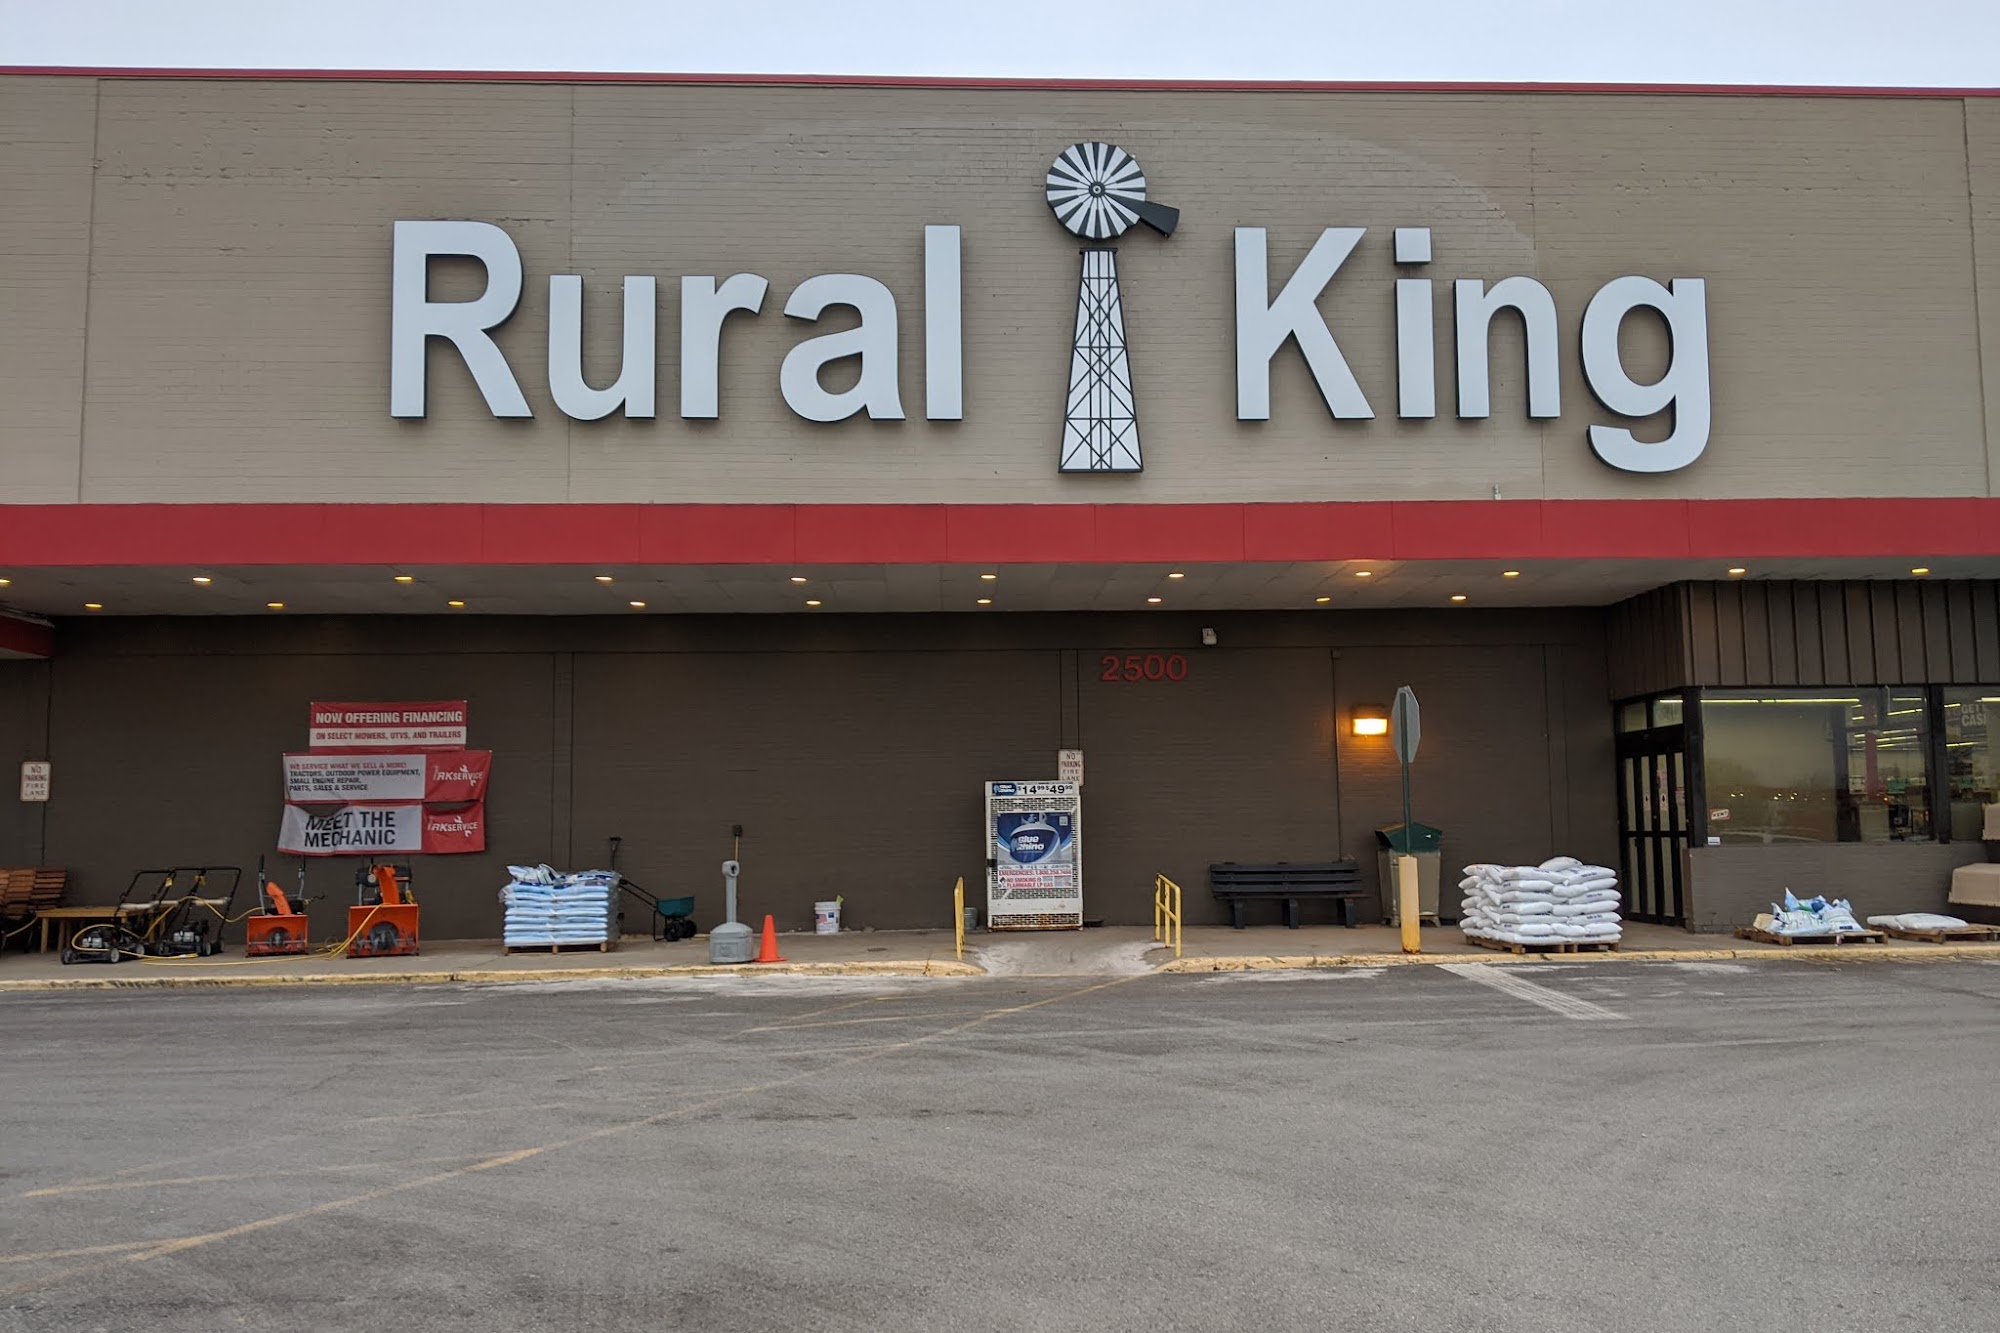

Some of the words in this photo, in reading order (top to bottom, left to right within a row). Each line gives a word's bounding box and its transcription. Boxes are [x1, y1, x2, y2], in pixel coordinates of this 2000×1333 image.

[391, 220, 964, 422] Rural
[1233, 227, 1712, 474] King
[1102, 654, 1188, 681] 2500
[316, 713, 342, 724] NOW
[345, 712, 399, 723] OFFERING
[403, 711, 463, 722] FINANCING
[316, 732, 326, 740] ON
[327, 732, 352, 740] SELECT
[354, 732, 388, 740] MOWERS,
[413, 731, 427, 739] AND
[306, 812, 353, 830] MEET
[359, 811, 396, 828] THE
[304, 829, 396, 847] MECHANIC
